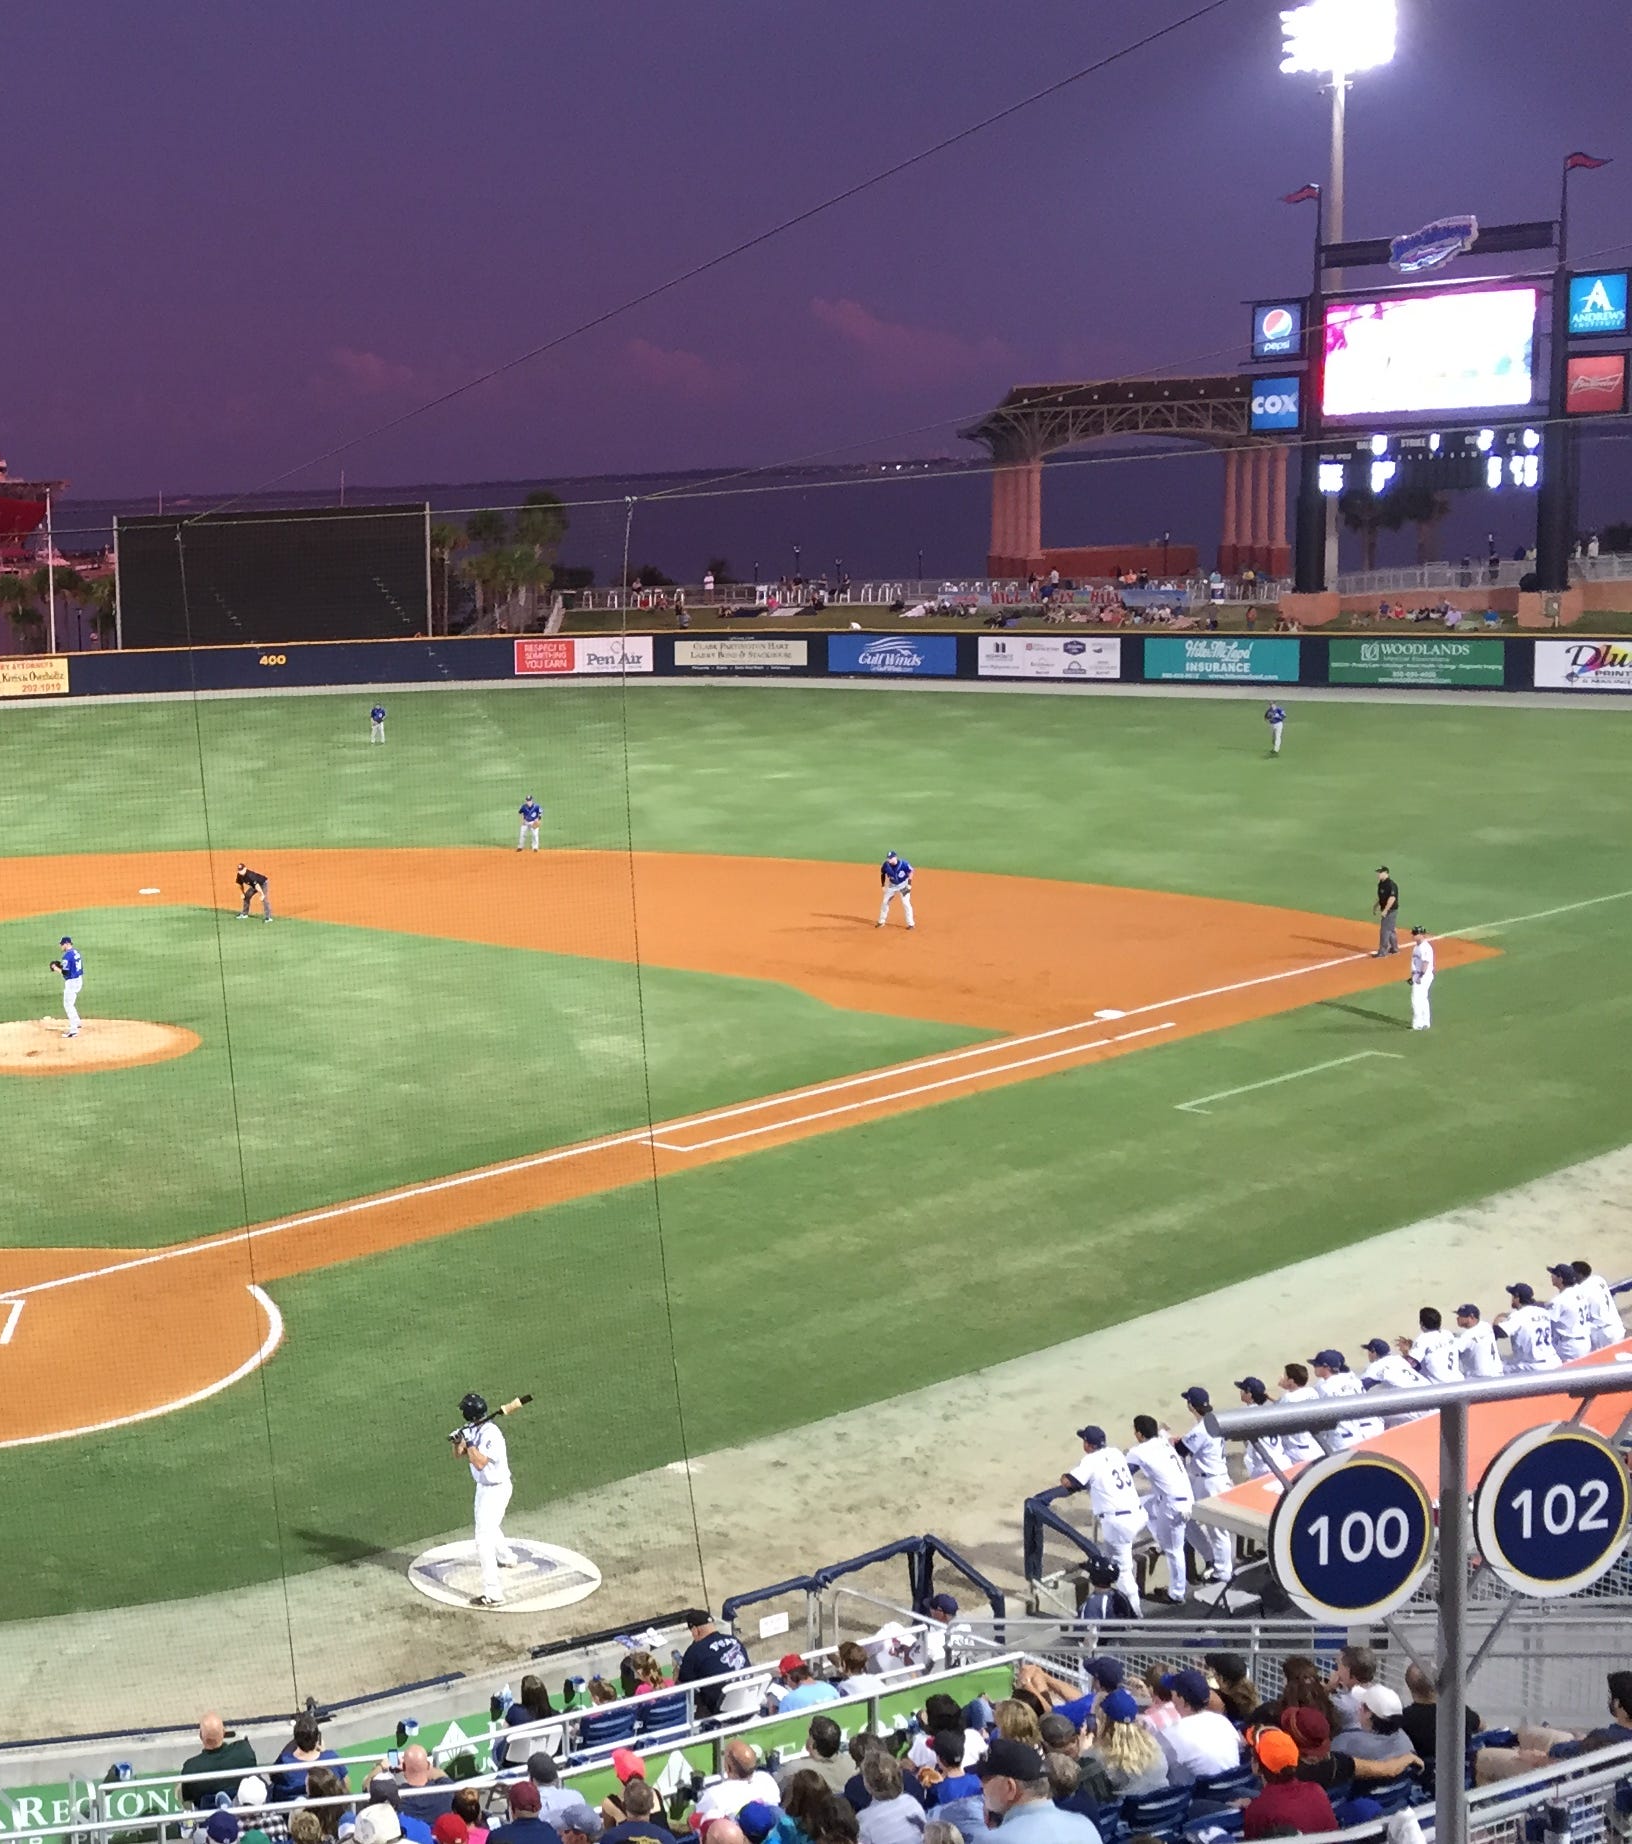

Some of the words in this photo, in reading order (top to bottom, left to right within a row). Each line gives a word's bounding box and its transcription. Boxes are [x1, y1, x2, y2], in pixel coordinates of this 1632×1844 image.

[1572, 310, 1625, 323] ANDREWS
[1264, 340, 1290, 352] pepsi
[524, 643, 557, 652] RESPECT
[558, 643, 567, 651] IS
[1380, 644, 1471, 655] WOODLANDS
[259, 654, 286, 665] 400
[525, 651, 567, 660] SOMETHING
[586, 653, 616, 665] Pen
[618, 652, 643, 665] Air
[858, 652, 886, 665] Gulf
[886, 653, 922, 666] Winds
[525, 660, 544, 668] YOU
[544, 659, 567, 668] EARN
[1185, 662, 1251, 672] INSURANCE
[1511, 1479, 1609, 1539] 102
[1307, 1507, 1410, 1566] 100
[16, 1788, 181, 1828] REGION
